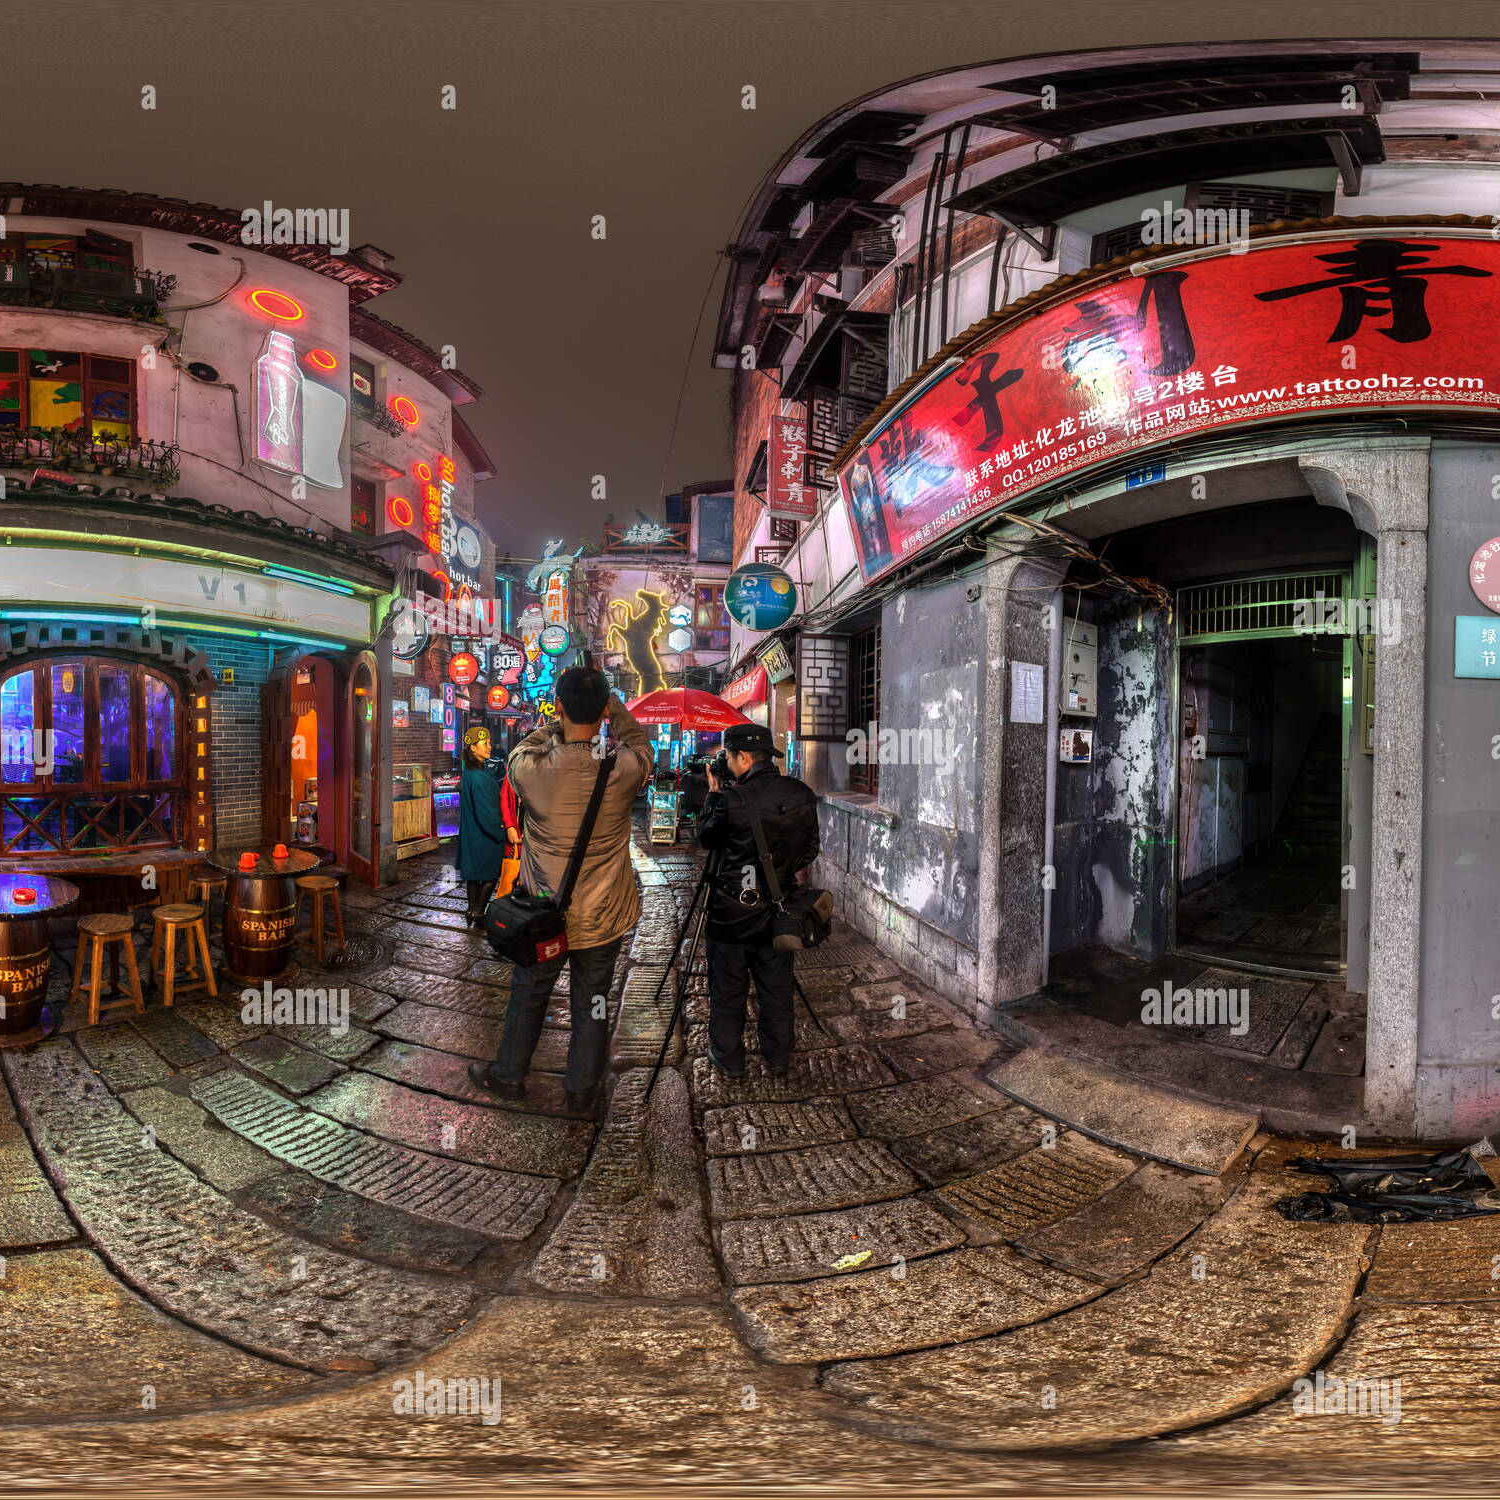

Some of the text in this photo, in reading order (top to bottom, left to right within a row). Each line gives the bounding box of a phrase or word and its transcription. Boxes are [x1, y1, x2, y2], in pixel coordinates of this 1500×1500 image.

[1001, 431, 1108, 488] QQ:120185169
[1481, 628, 1497, 645] 绿
[1481, 650, 1497, 667] 节
[242, 916, 296, 931] SPANISH
[258, 929, 286, 942] BAR
[11, 976, 44, 994] BAR
